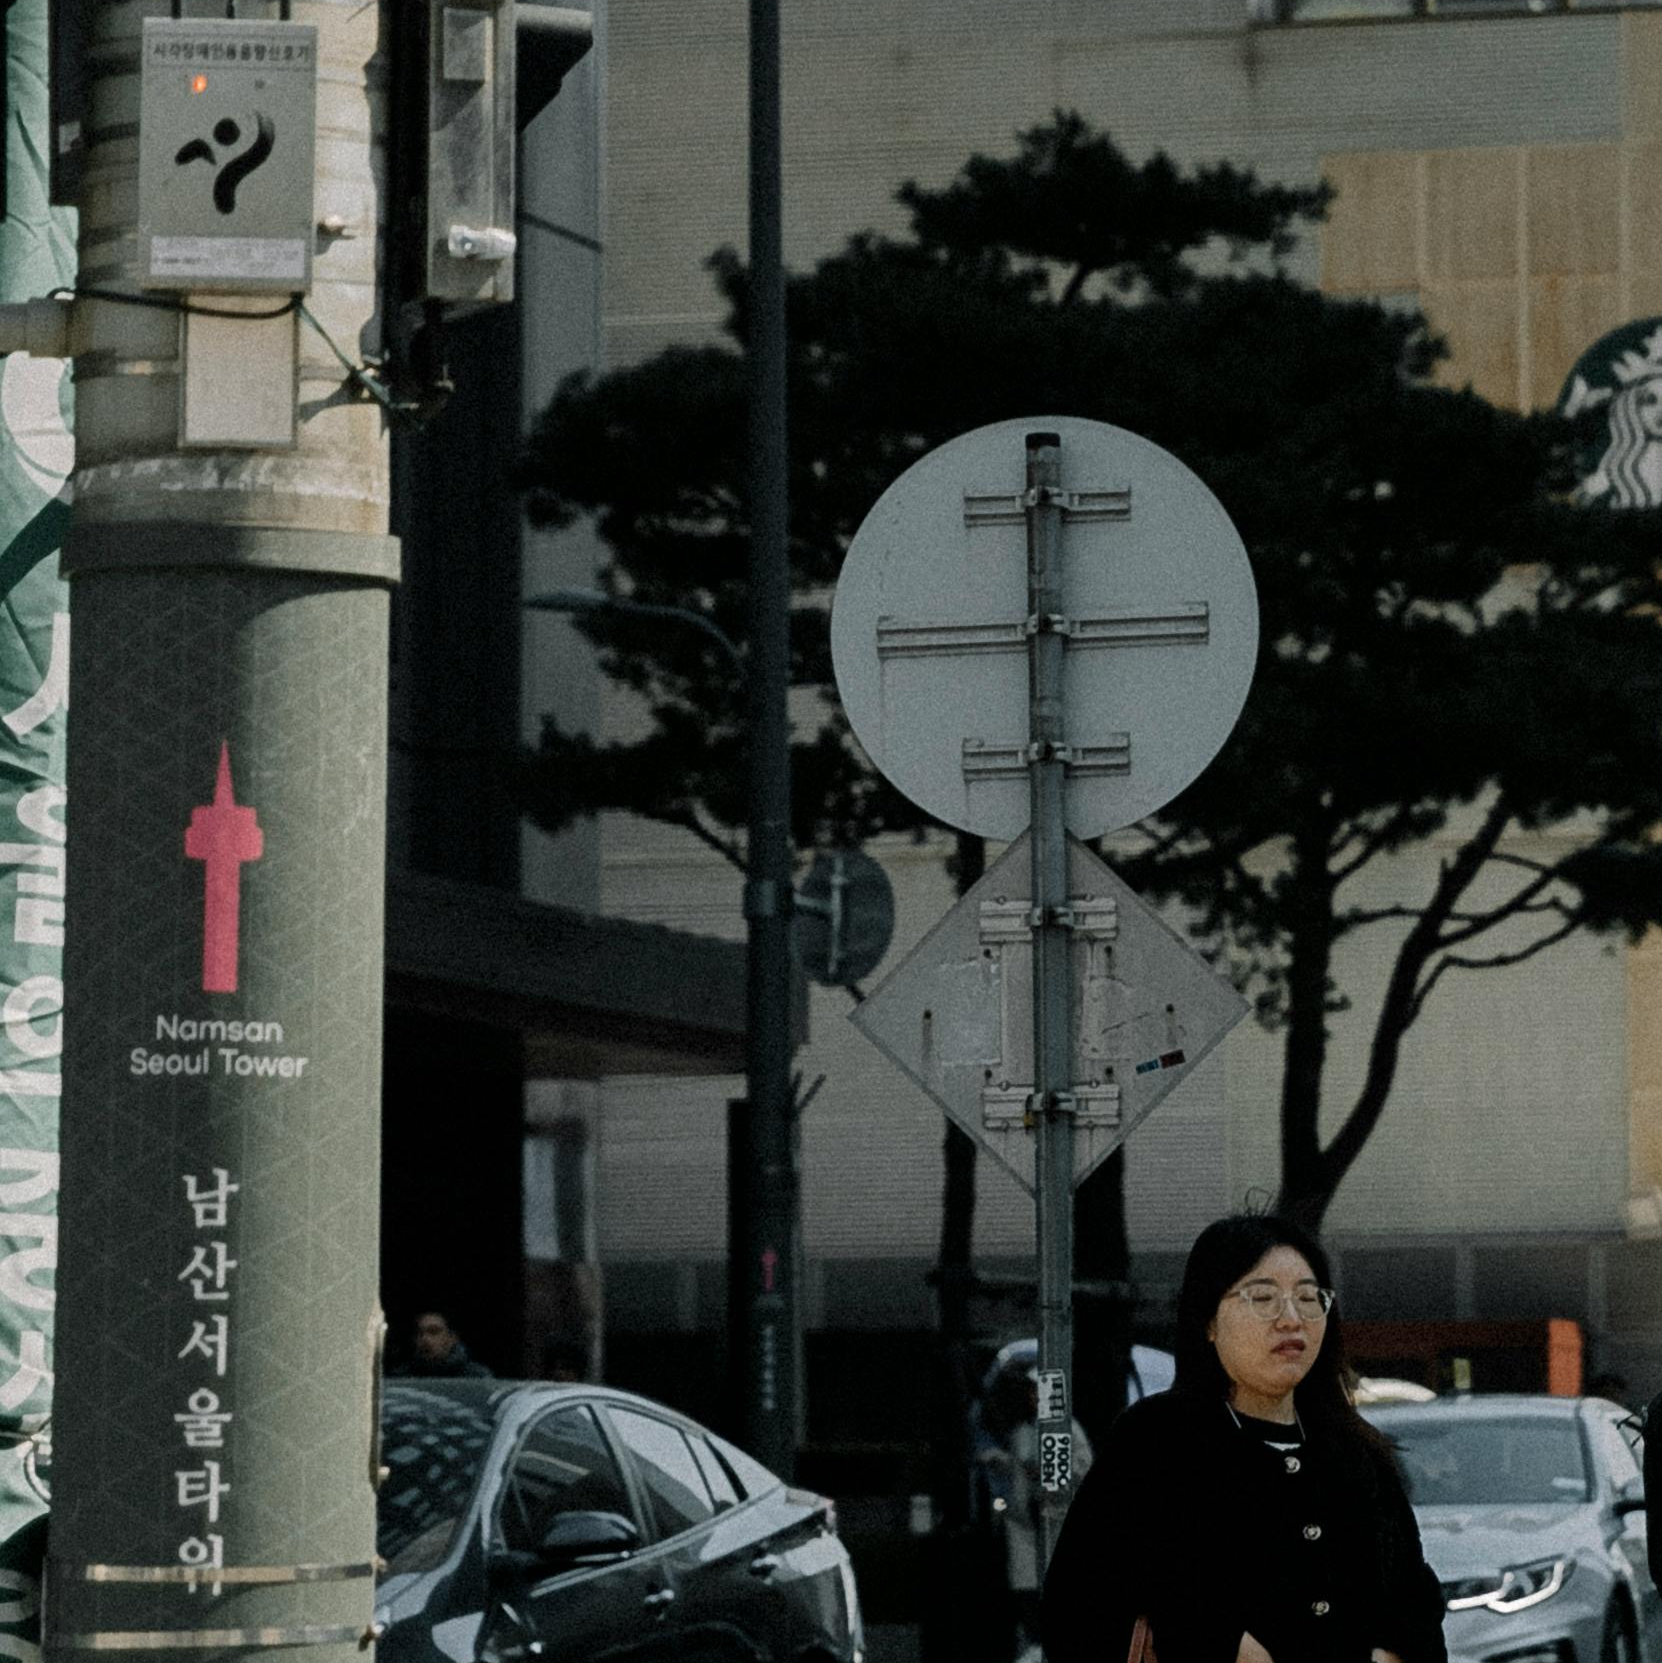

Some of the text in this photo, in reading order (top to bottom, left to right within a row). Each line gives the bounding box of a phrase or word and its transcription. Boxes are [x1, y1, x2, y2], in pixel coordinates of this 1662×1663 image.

[156, 1014, 284, 1043] Namsan
[130, 1047, 309, 1077] Seoul Tower
